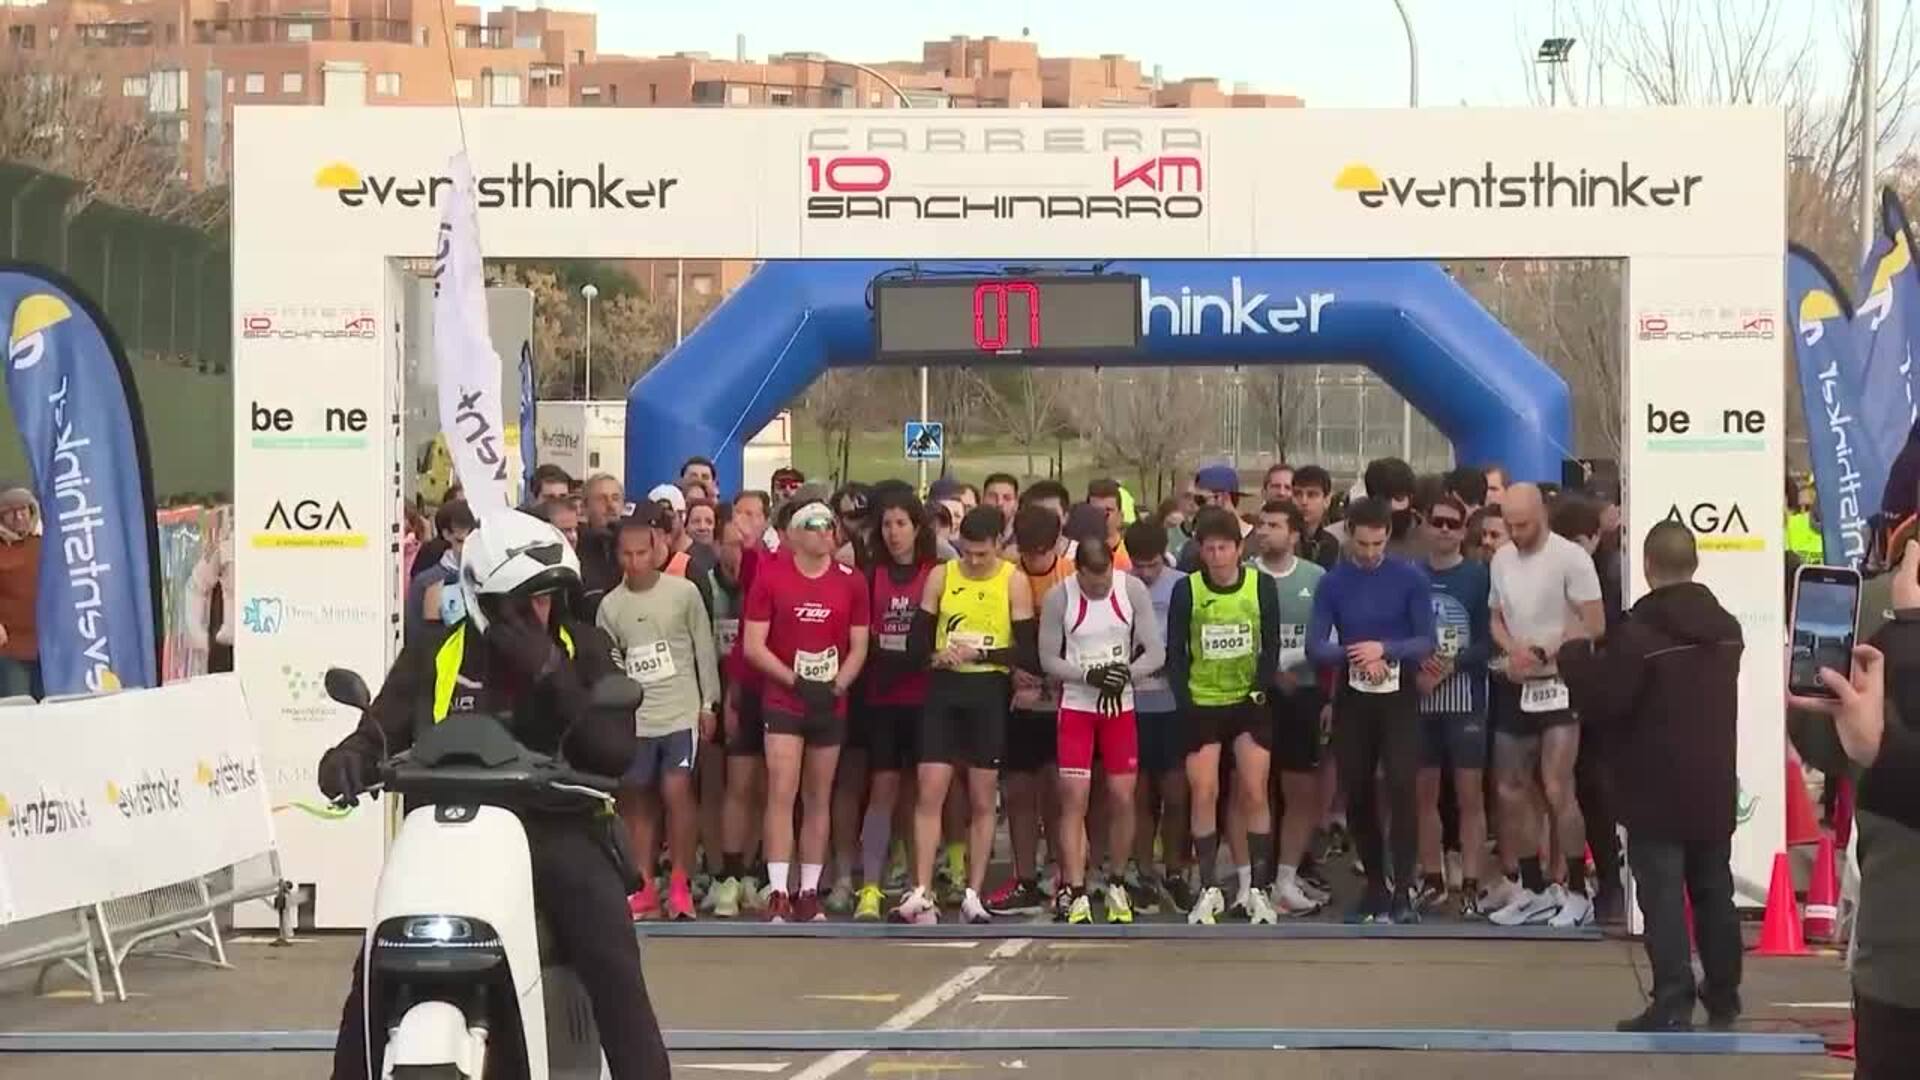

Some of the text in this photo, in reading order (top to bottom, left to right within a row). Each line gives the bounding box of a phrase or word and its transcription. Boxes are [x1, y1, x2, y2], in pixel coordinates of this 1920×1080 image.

[807, 128, 1203, 152] CARRERA
[338, 162, 678, 209] evensthinker
[807, 156, 1202, 193] 10 KM
[1358, 161, 1703, 209] eventsthinker
[807, 195, 1203, 219] SANCHINARRO
[1142, 276, 1336, 336] hinker
[243, 317, 272, 330] 10
[1639, 318, 1668, 332] 10
[264, 500, 352, 531] AGA
